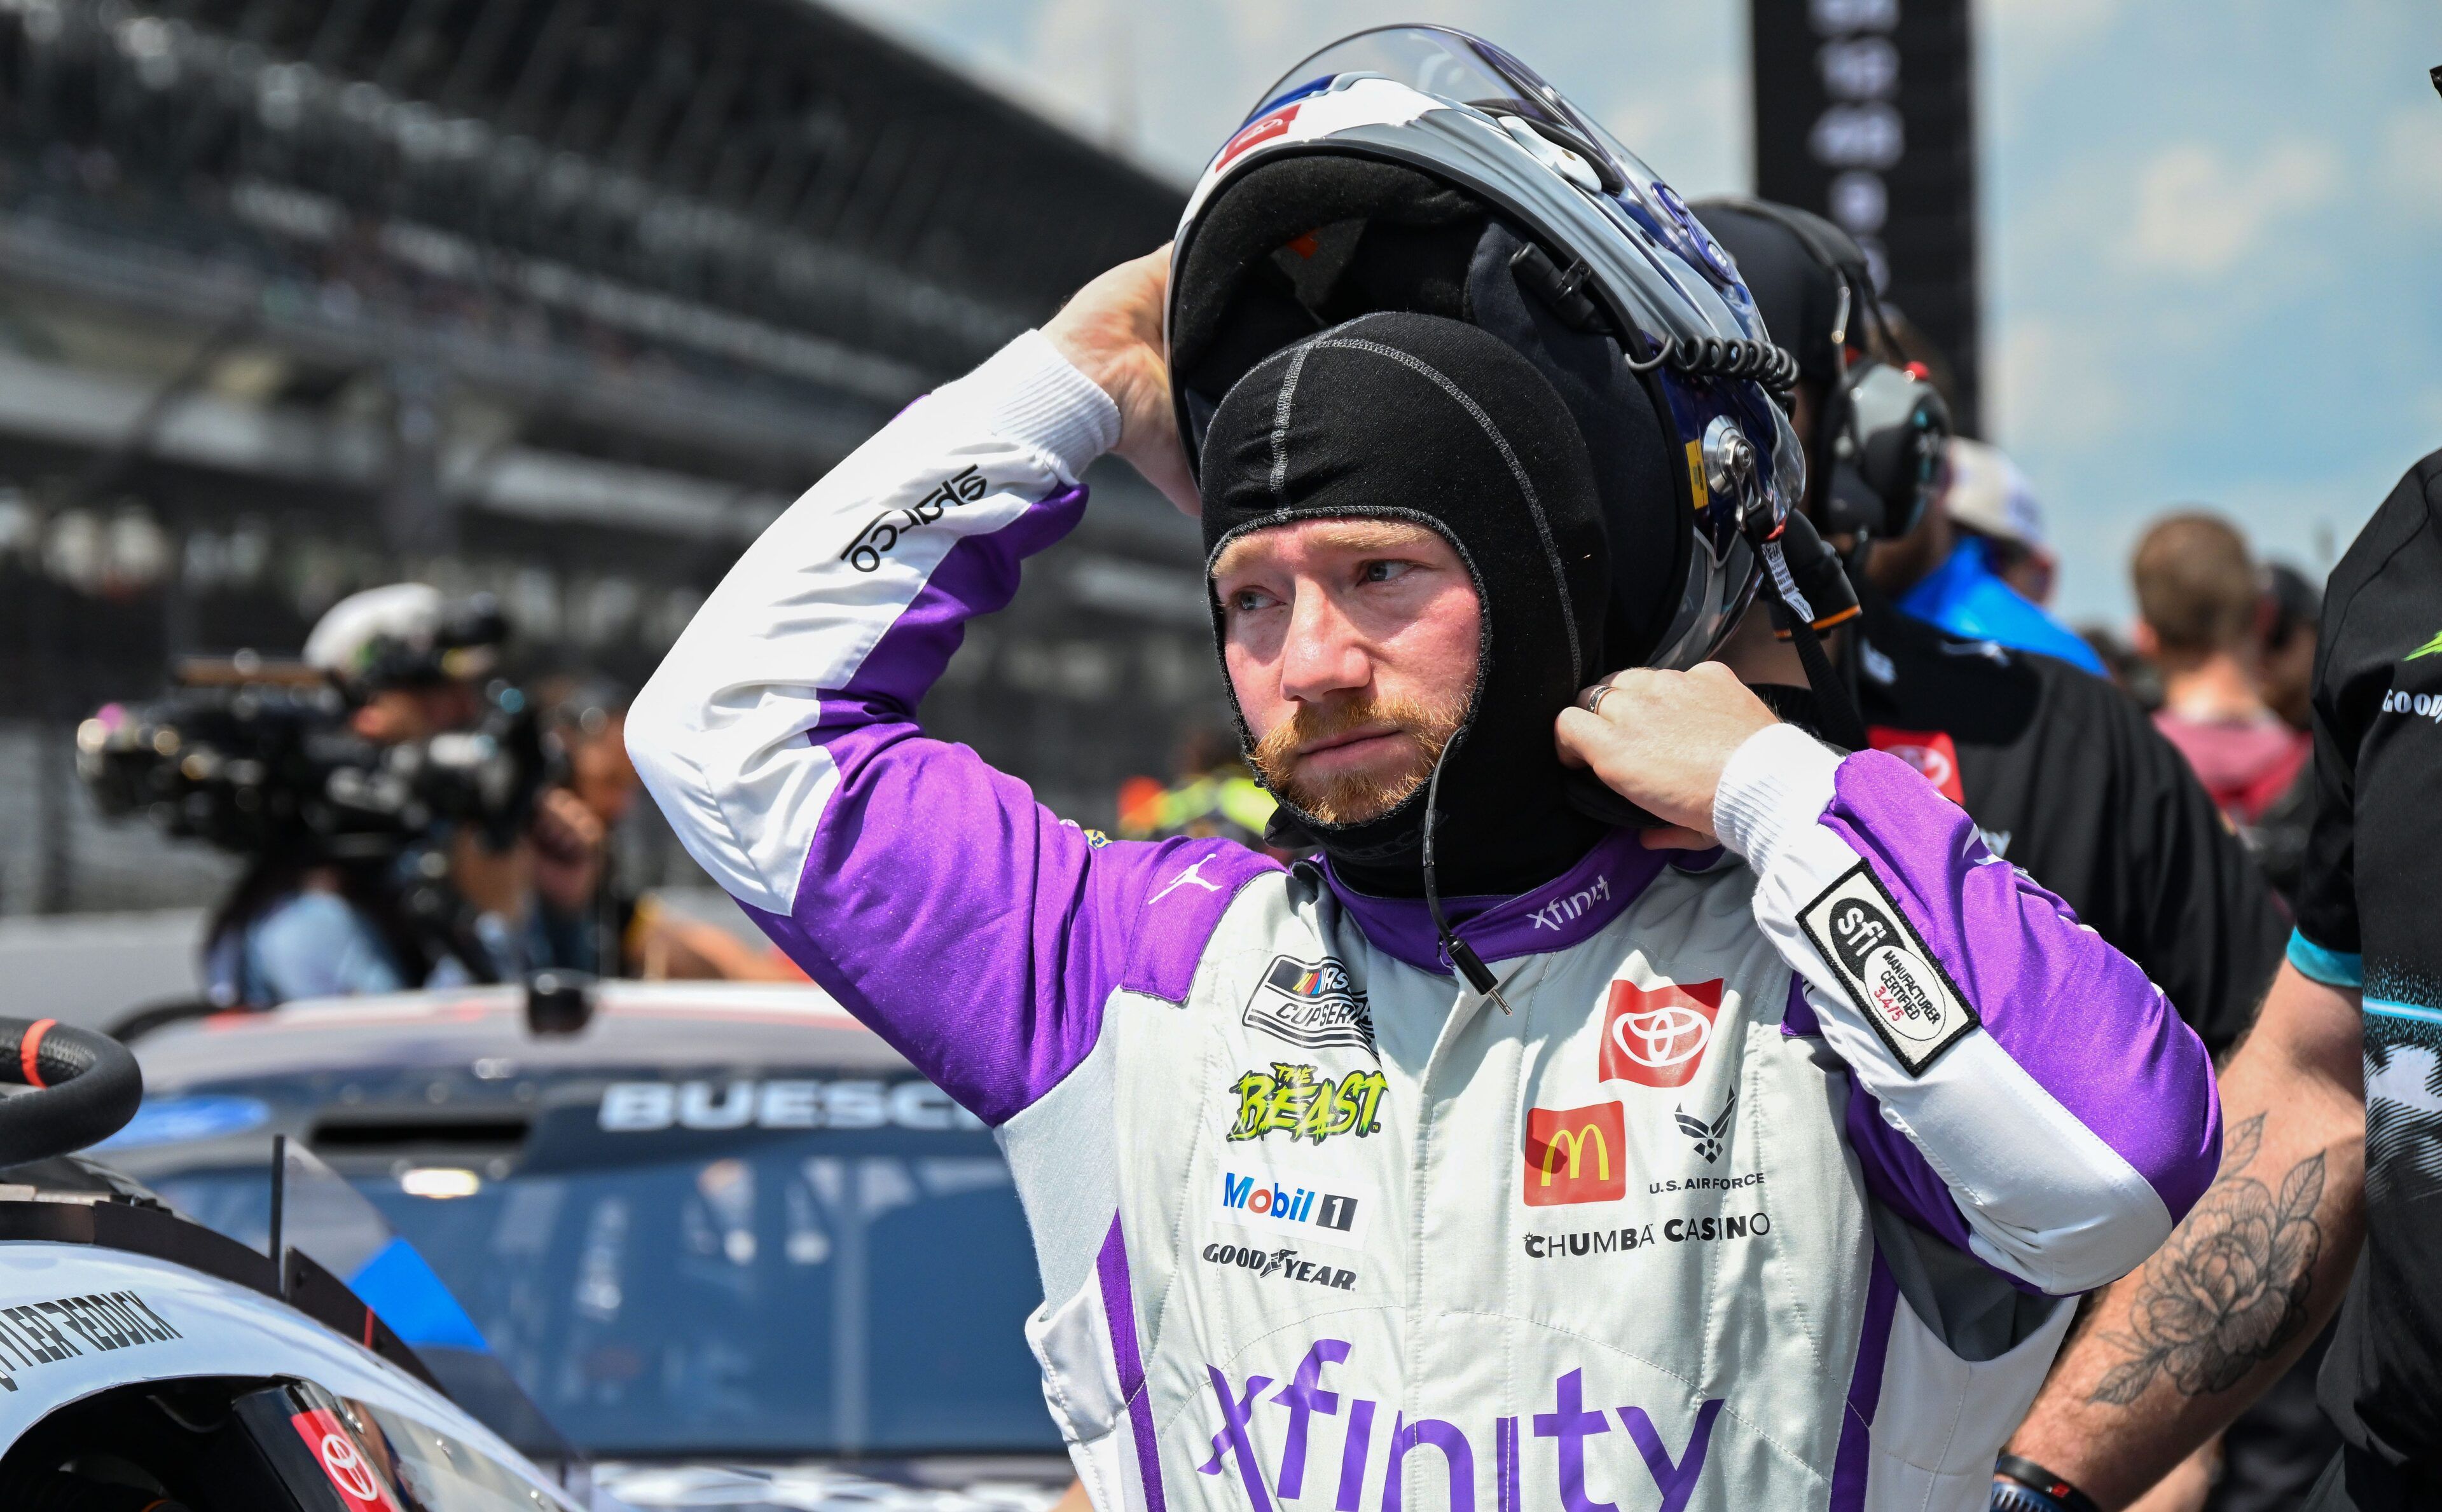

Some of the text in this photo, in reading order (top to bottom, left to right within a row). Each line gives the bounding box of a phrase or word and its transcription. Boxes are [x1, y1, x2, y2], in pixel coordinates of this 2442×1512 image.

[840, 464, 987, 572] sparco
[1838, 907, 1887, 956] sfi
[1874, 986, 1905, 1022] 3.4/5
[1880, 970, 1921, 1021] CERTIFIED
[1882, 951, 1941, 1025] MANUFACTURER
[1276, 1003, 1321, 1027] CUP
[1274, 1064, 1315, 1083] THE
[598, 1080, 986, 1132] BUESC
[1227, 1072, 1389, 1143] BEAST
[1223, 1172, 1315, 1223] Mobil
[1649, 1180, 1681, 1194] U.S.
[1524, 1212, 1770, 1258] CHUMBA CASINO
[32, 1289, 184, 1352] REDDICK
[1197, 1338, 1725, 1512] xfinity
